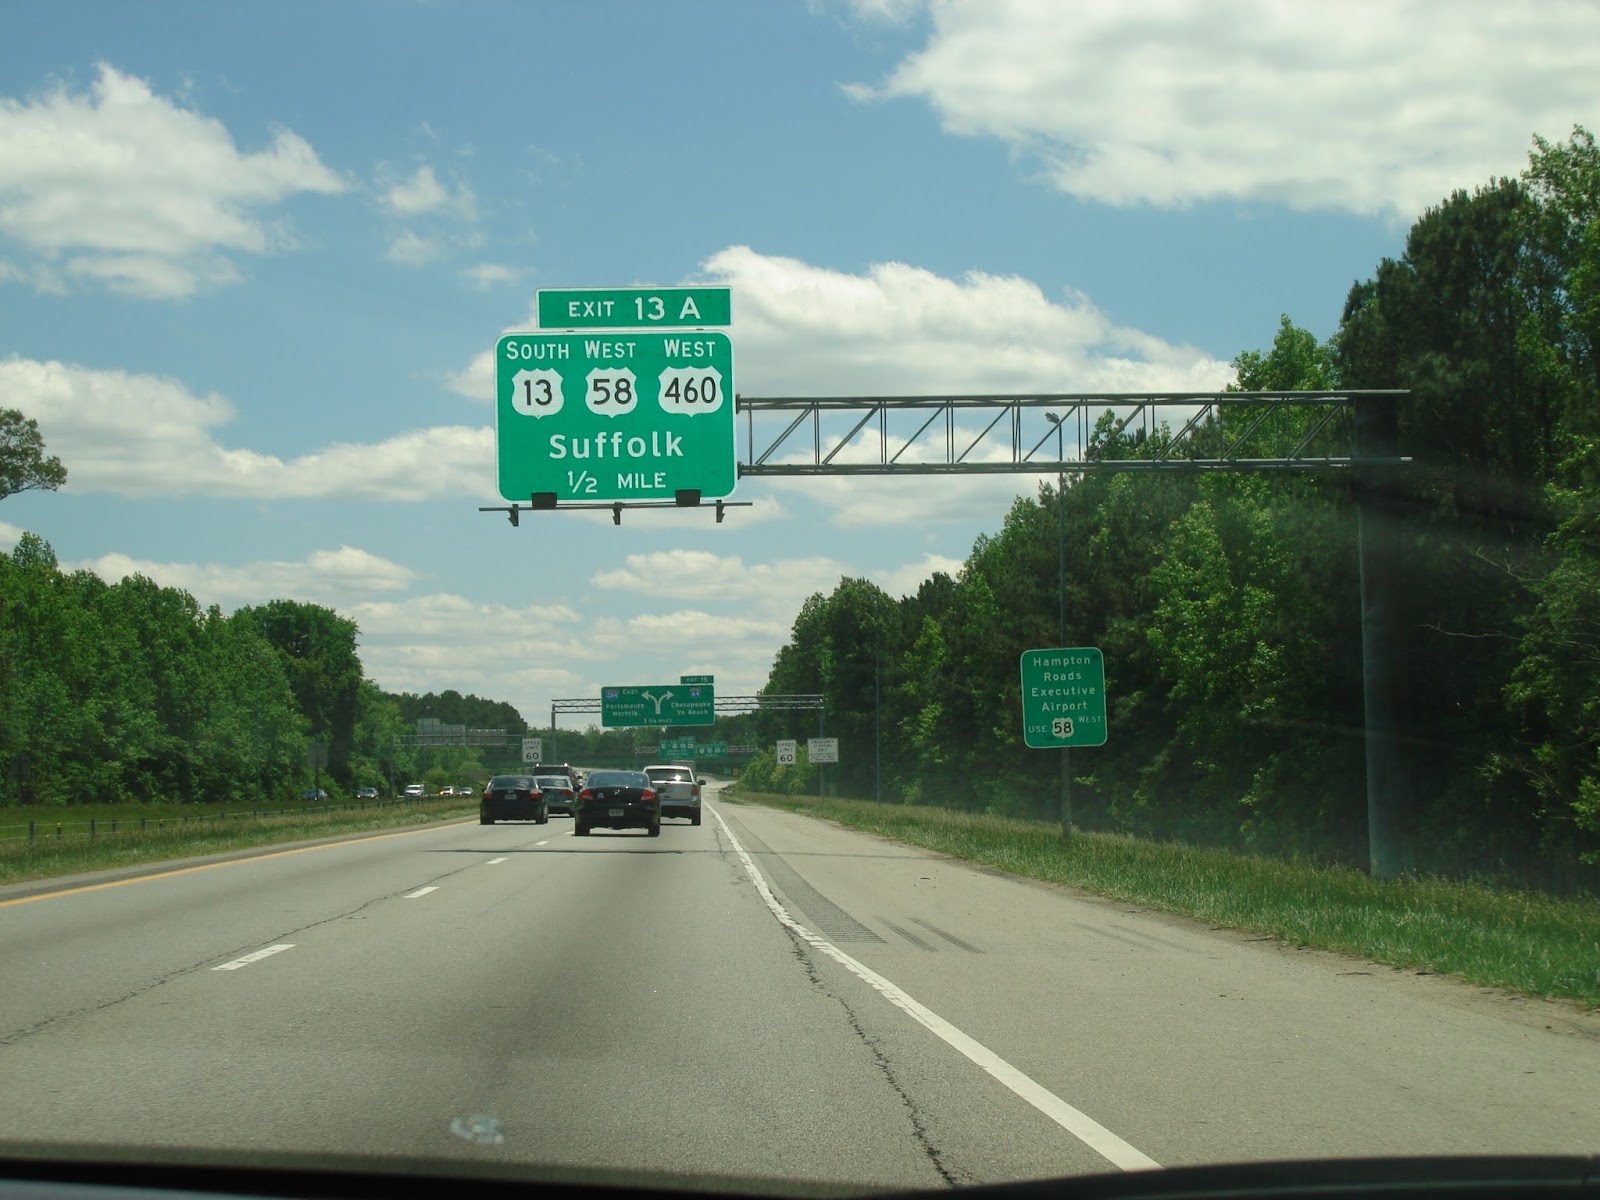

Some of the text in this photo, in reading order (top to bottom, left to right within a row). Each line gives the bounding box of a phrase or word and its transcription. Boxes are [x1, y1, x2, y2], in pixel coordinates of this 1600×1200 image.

[568, 296, 701, 320] EXIT 13 A
[506, 339, 716, 360] SOUTH WEST WEST
[524, 376, 717, 406] 13 58 460
[549, 431, 684, 459] Suffolk
[567, 470, 666, 493] 1/2 MILE
[1033, 656, 1091, 667] Hampton
[1044, 671, 1082, 681] Roads
[1031, 686, 1096, 697] Executive
[1041, 701, 1088, 713] Airport
[1028, 715, 1102, 734] USE 58 WEST
[525, 752, 539, 760] 60
[780, 754, 793, 762] 60
